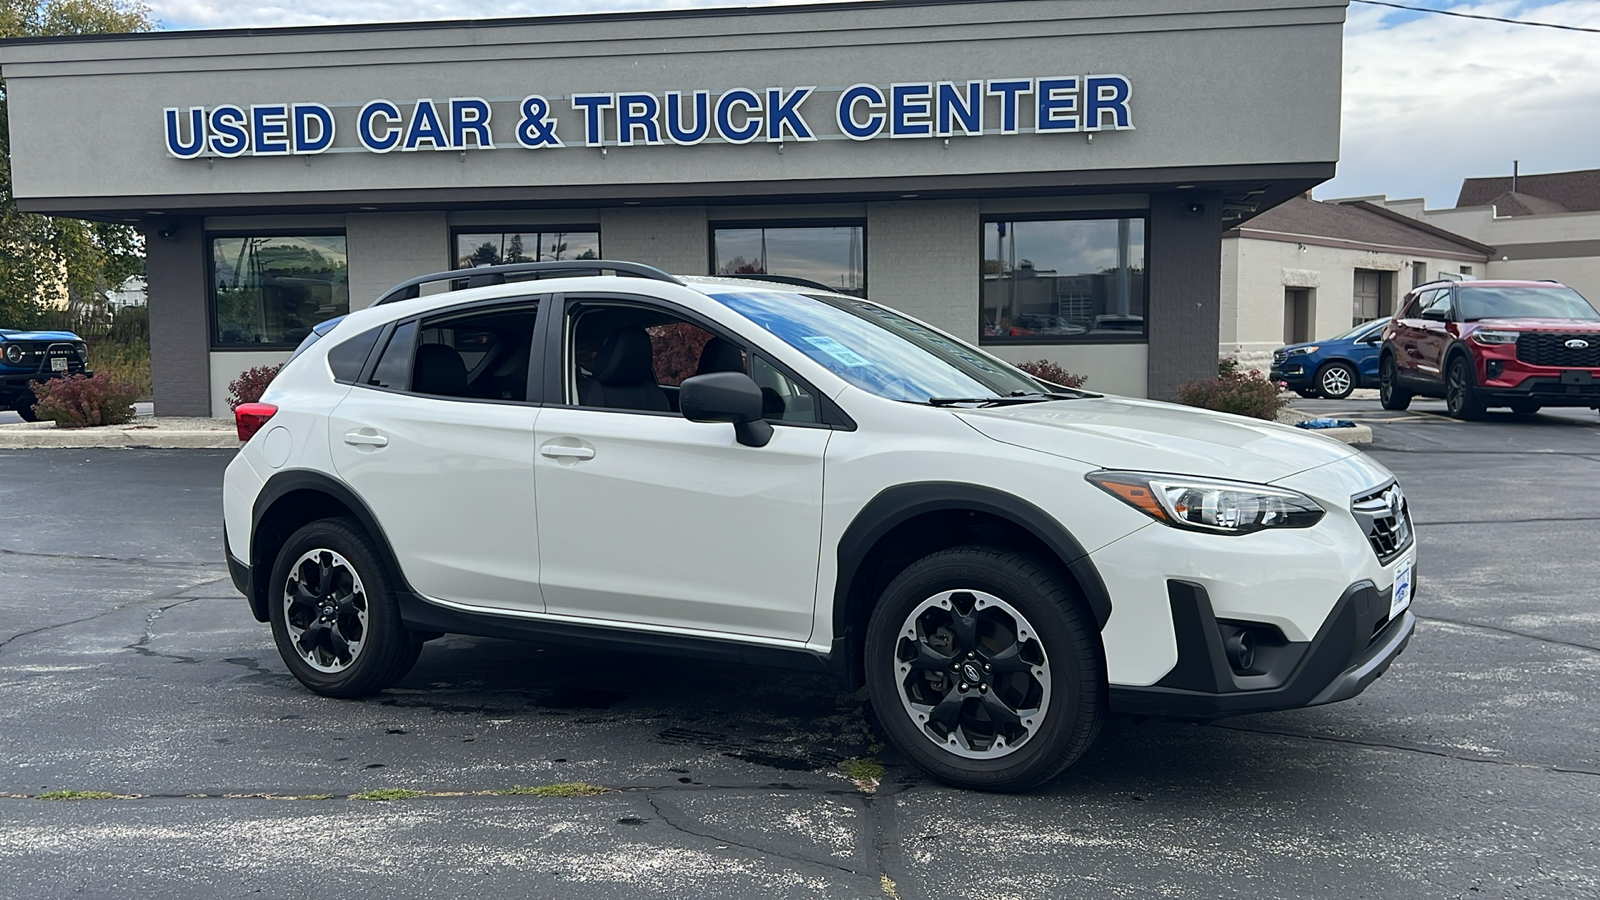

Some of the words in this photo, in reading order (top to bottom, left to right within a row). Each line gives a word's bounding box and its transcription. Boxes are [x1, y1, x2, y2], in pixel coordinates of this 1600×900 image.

[164, 102, 336, 159] USED
[356, 97, 497, 154] CAR
[514, 94, 566, 150] &
[571, 86, 818, 146] TRUCK
[836, 73, 1136, 141] CENTER
